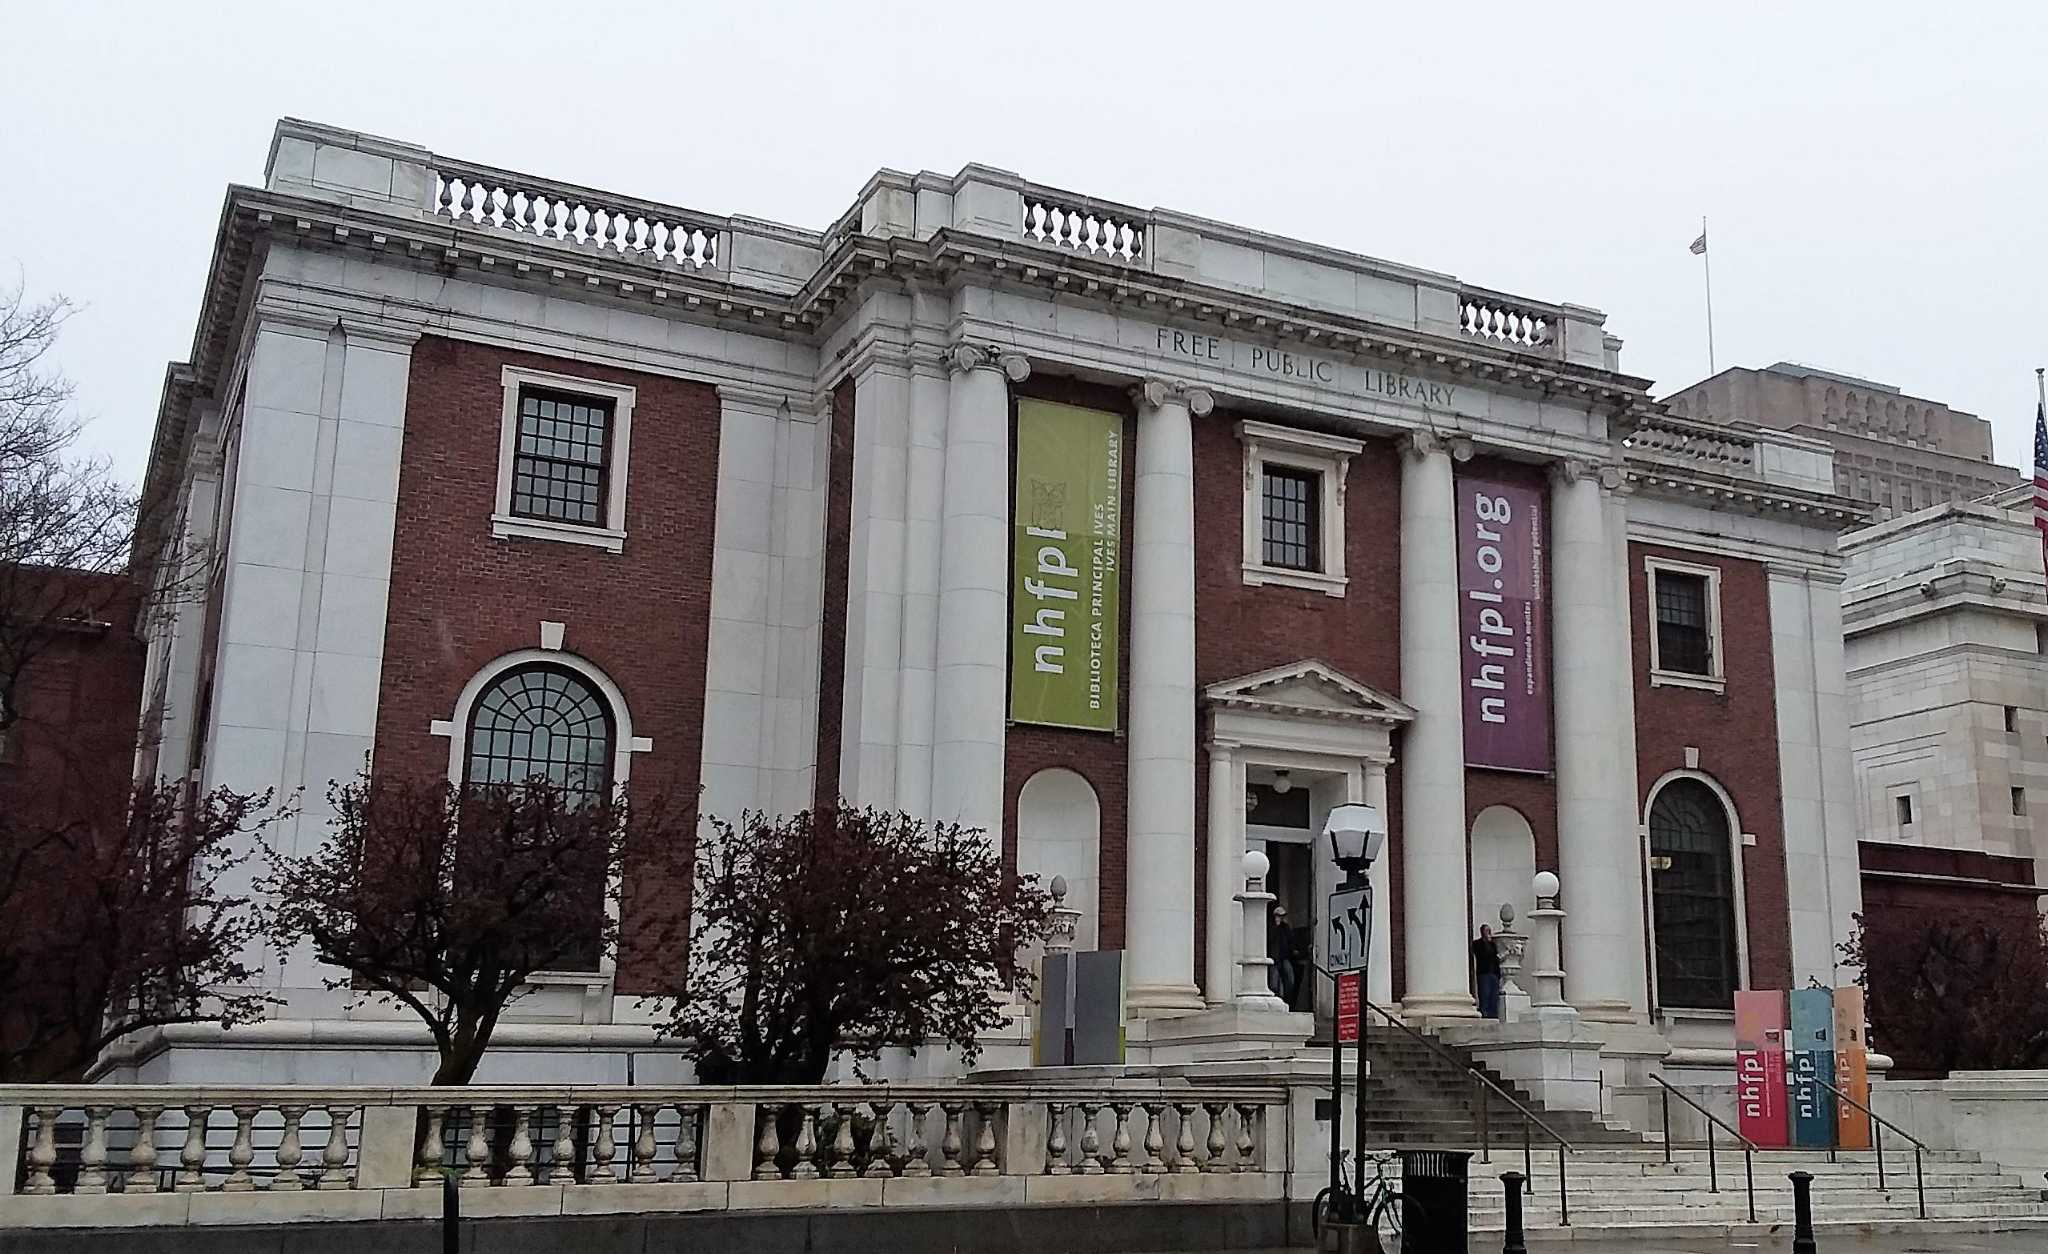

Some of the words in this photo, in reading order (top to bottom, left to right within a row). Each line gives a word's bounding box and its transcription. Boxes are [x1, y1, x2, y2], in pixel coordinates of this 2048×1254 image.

[1156, 328, 1220, 361] FREE
[1251, 347, 1333, 383] PUBLIC
[1364, 370, 1456, 406] LIBRARY
[1108, 430, 1119, 490] LIBRARY
[1094, 503, 1104, 535] IVES
[1107, 495, 1117, 537] MAIN
[1092, 539, 1104, 616] PRINCIPAL
[1106, 540, 1116, 572] IVES
[1024, 526, 1078, 674] nhfpl
[1469, 493, 1514, 723] nhfpl.org
[1090, 622, 1103, 708] BIBLIOTECA
[1330, 952, 1348, 967] ONLY
[1740, 1050, 1765, 1117] nhfpl
[1795, 1050, 1814, 1118] nhfpl
